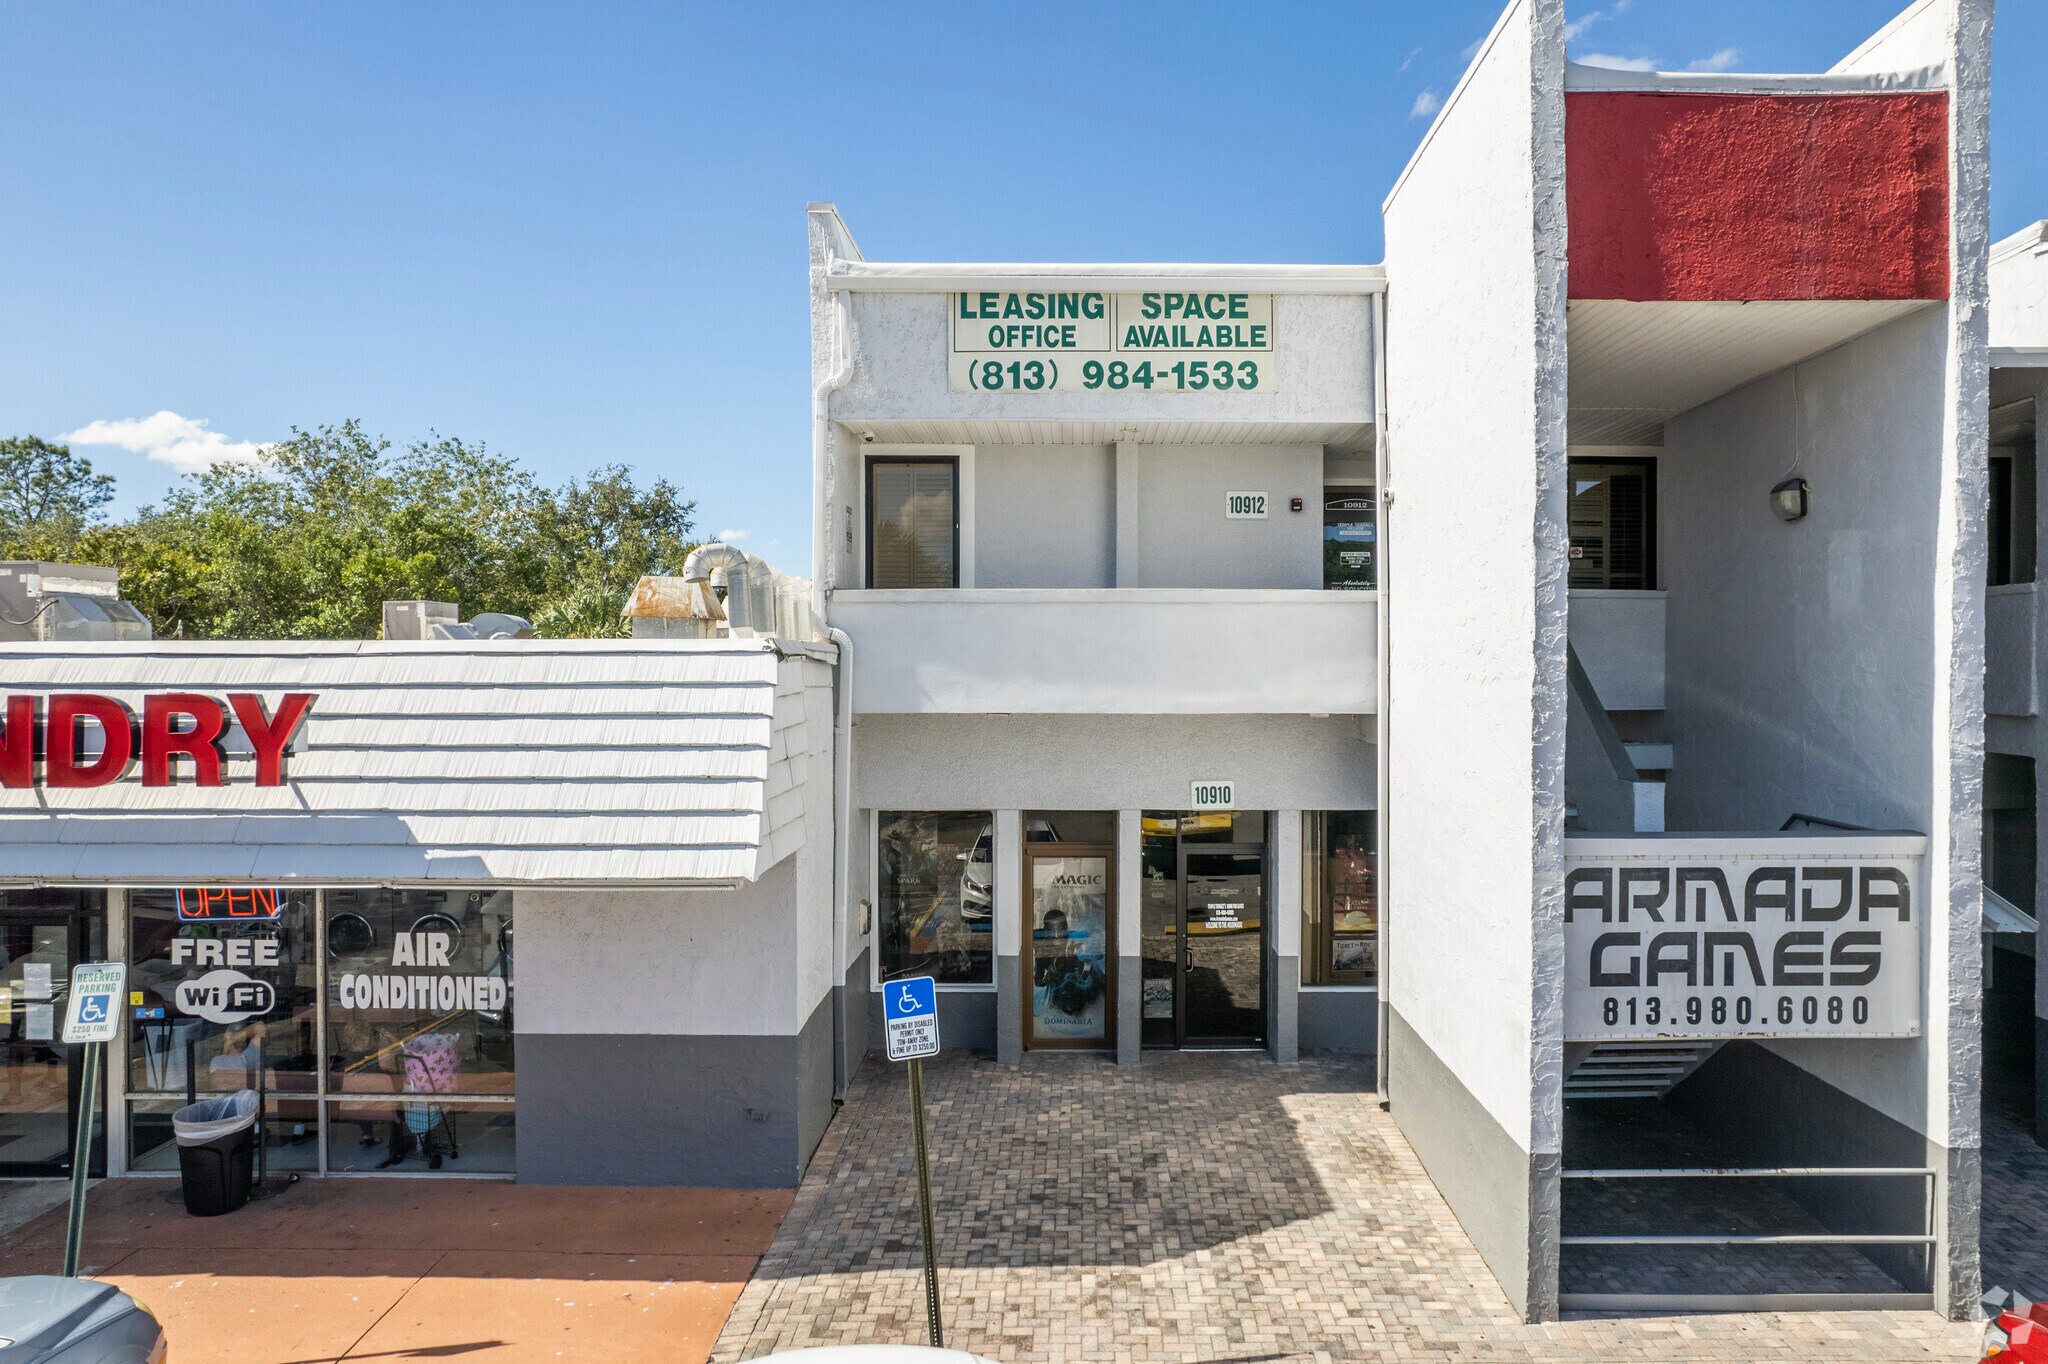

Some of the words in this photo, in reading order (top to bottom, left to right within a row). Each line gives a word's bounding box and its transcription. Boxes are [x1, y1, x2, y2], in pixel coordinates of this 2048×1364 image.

[960, 292, 1105, 320] LEASING
[1141, 293, 1249, 320] SPACE
[988, 324, 1077, 348] OFFICE
[1123, 325, 1267, 348] AVAILABLE
[968, 358, 1058, 391] (813)
[1082, 360, 1259, 391] 984-1533
[1229, 495, 1265, 514] 10912
[1195, 785, 1231, 805] 10910
[1051, 874, 1103, 885] MAGIC
[1564, 866, 1911, 922] ARMADA
[171, 938, 280, 967] FREE
[391, 932, 451, 967] AIR
[1589, 930, 1882, 987] GAMES
[78, 972, 120, 982] RESERVED
[78, 983, 117, 993] PARKING
[339, 973, 507, 1011] CONDITIONED
[1603, 995, 1869, 1026] 813.980.6080
[93, 1024, 108, 1032] FINE
[890, 1022, 907, 1031] PARKING
